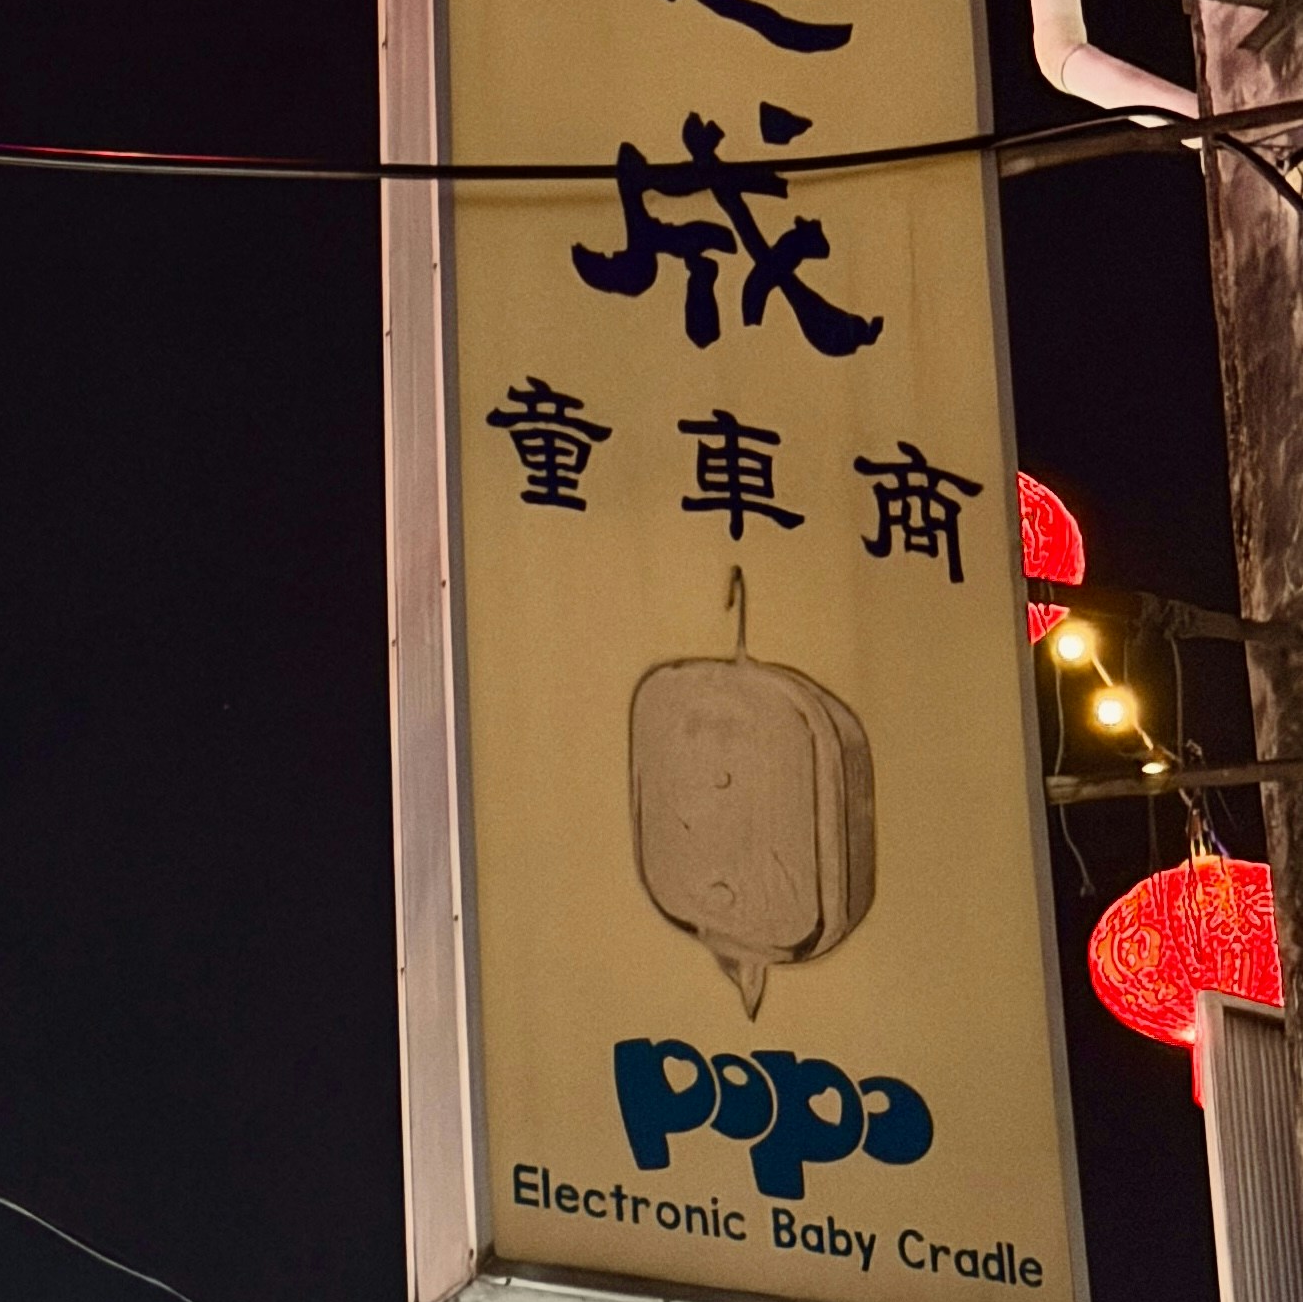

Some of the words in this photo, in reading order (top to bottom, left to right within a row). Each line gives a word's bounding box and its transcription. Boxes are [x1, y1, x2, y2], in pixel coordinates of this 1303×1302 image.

[486, 376, 984, 584] 童車商
[512, 1163, 747, 1243] Electronic
[771, 1207, 876, 1273] Baby
[897, 1229, 1044, 1289] Cradle
